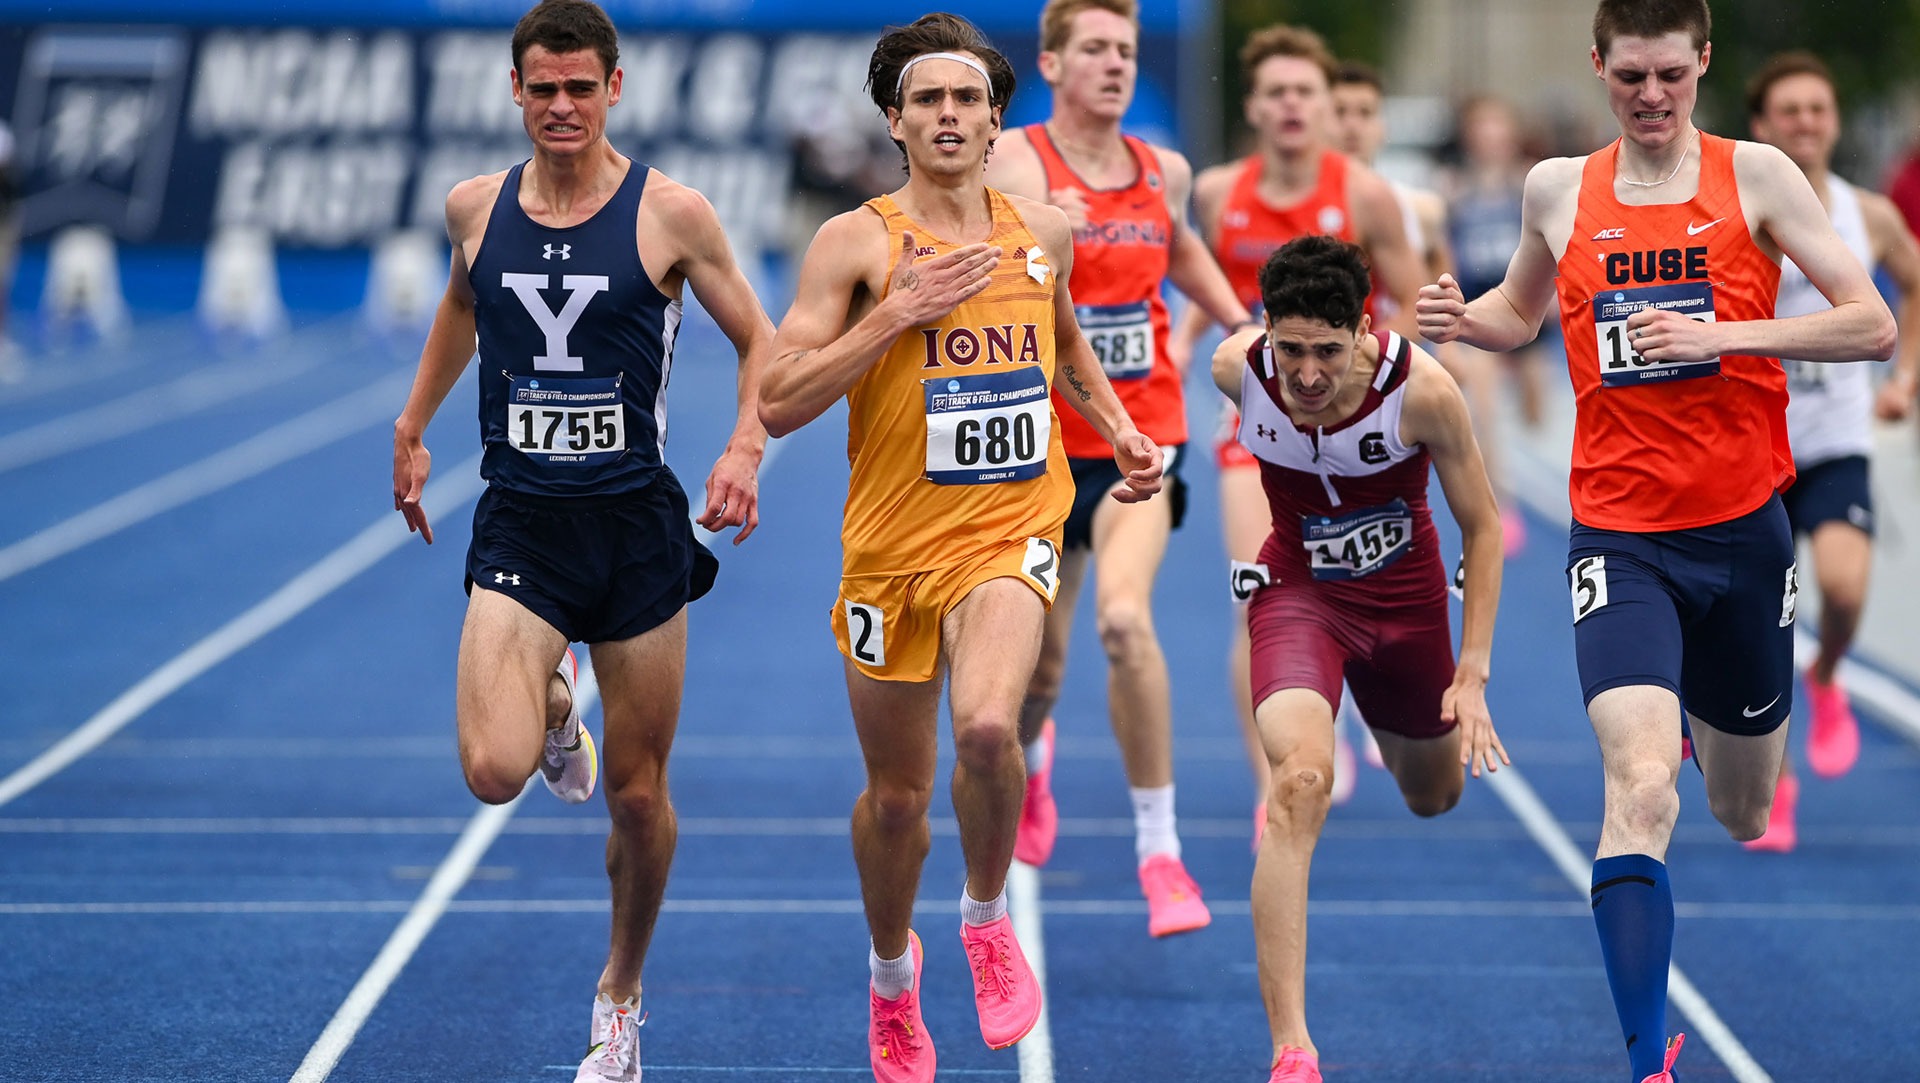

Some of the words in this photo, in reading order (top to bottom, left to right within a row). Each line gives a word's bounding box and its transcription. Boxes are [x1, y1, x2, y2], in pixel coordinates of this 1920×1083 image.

[1592, 227, 1626, 240] ACC
[1597, 246, 1709, 285] 'CUSE
[501, 272, 609, 372] Y
[1615, 303, 1633, 313] TRACK
[1655, 297, 1705, 310] CHAMPIONSHIPS
[920, 324, 1040, 370] IONA
[529, 392, 547, 400] TRACK
[552, 393, 568, 401] FIELD
[568, 392, 616, 401] CHAMPIONSHIPS
[948, 395, 972, 406] TRACK
[978, 393, 998, 404] FIELD
[999, 385, 1045, 402] CHAMPIONSHIPS
[519, 409, 617, 451] 1755
[954, 412, 1036, 466] 680
[1030, 539, 1055, 590] 2
[1316, 520, 1404, 569] 1455
[1577, 558, 1597, 616] 5
[851, 606, 876, 663] 2
